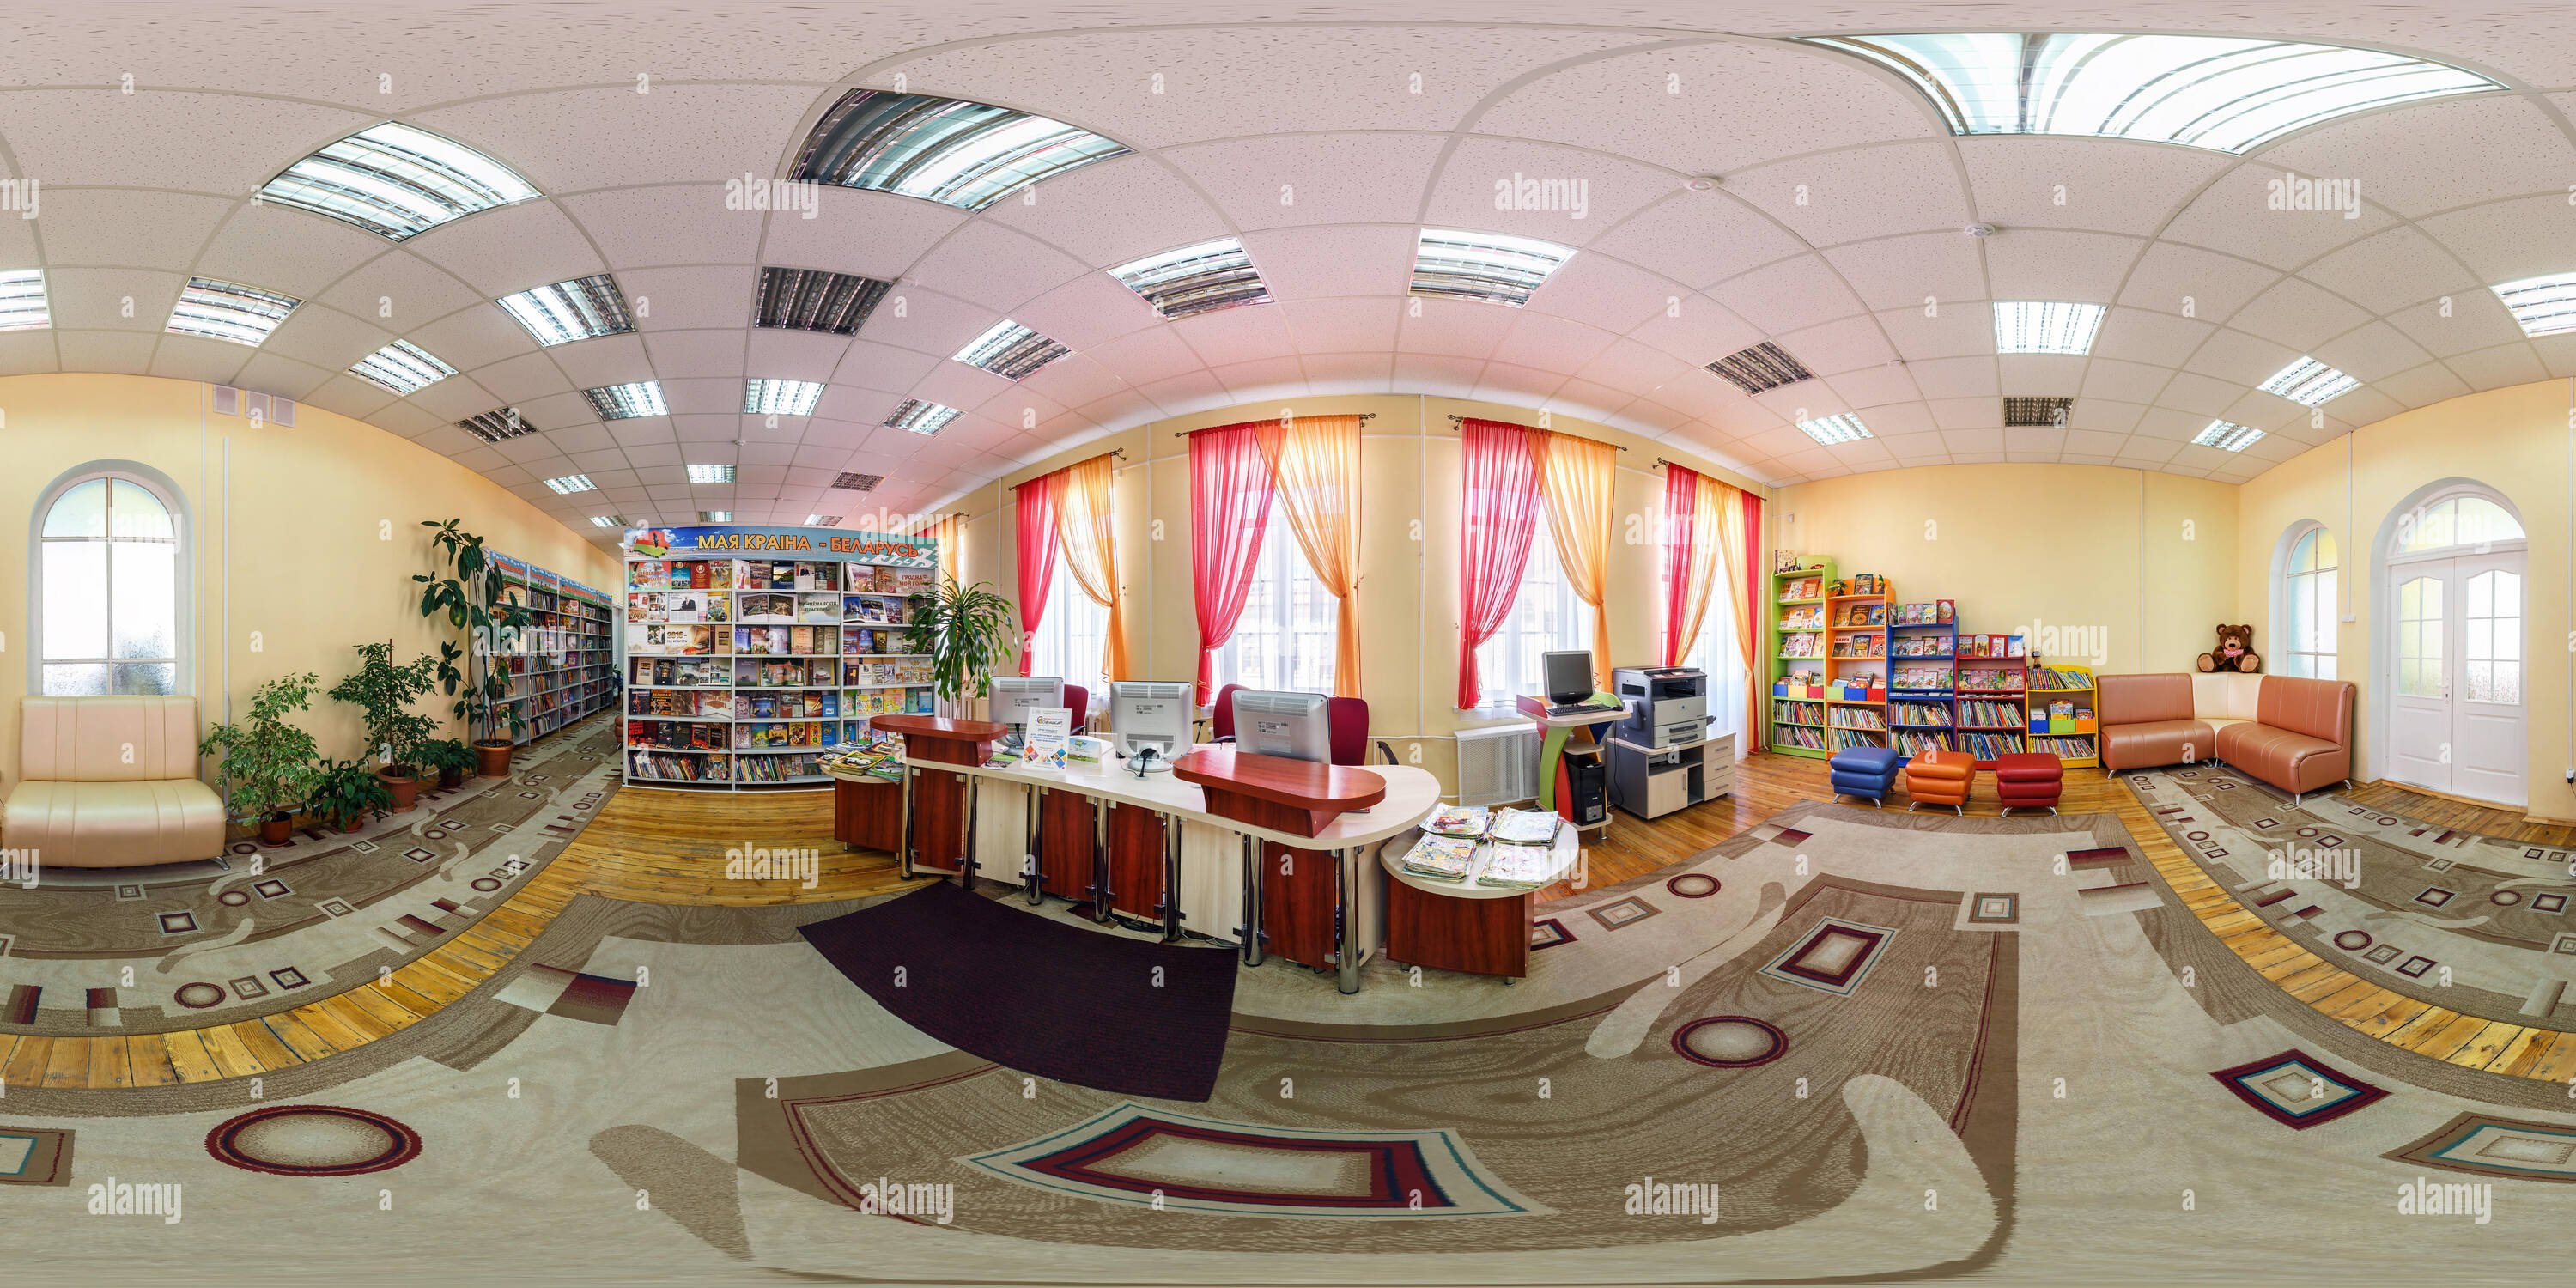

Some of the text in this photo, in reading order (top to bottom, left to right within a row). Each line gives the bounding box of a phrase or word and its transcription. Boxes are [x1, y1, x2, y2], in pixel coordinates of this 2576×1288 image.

[698, 534, 739, 550] МАЯ
[744, 534, 811, 550] КРАІНА
[831, 537, 918, 557] БЕЛАРУСЬ
